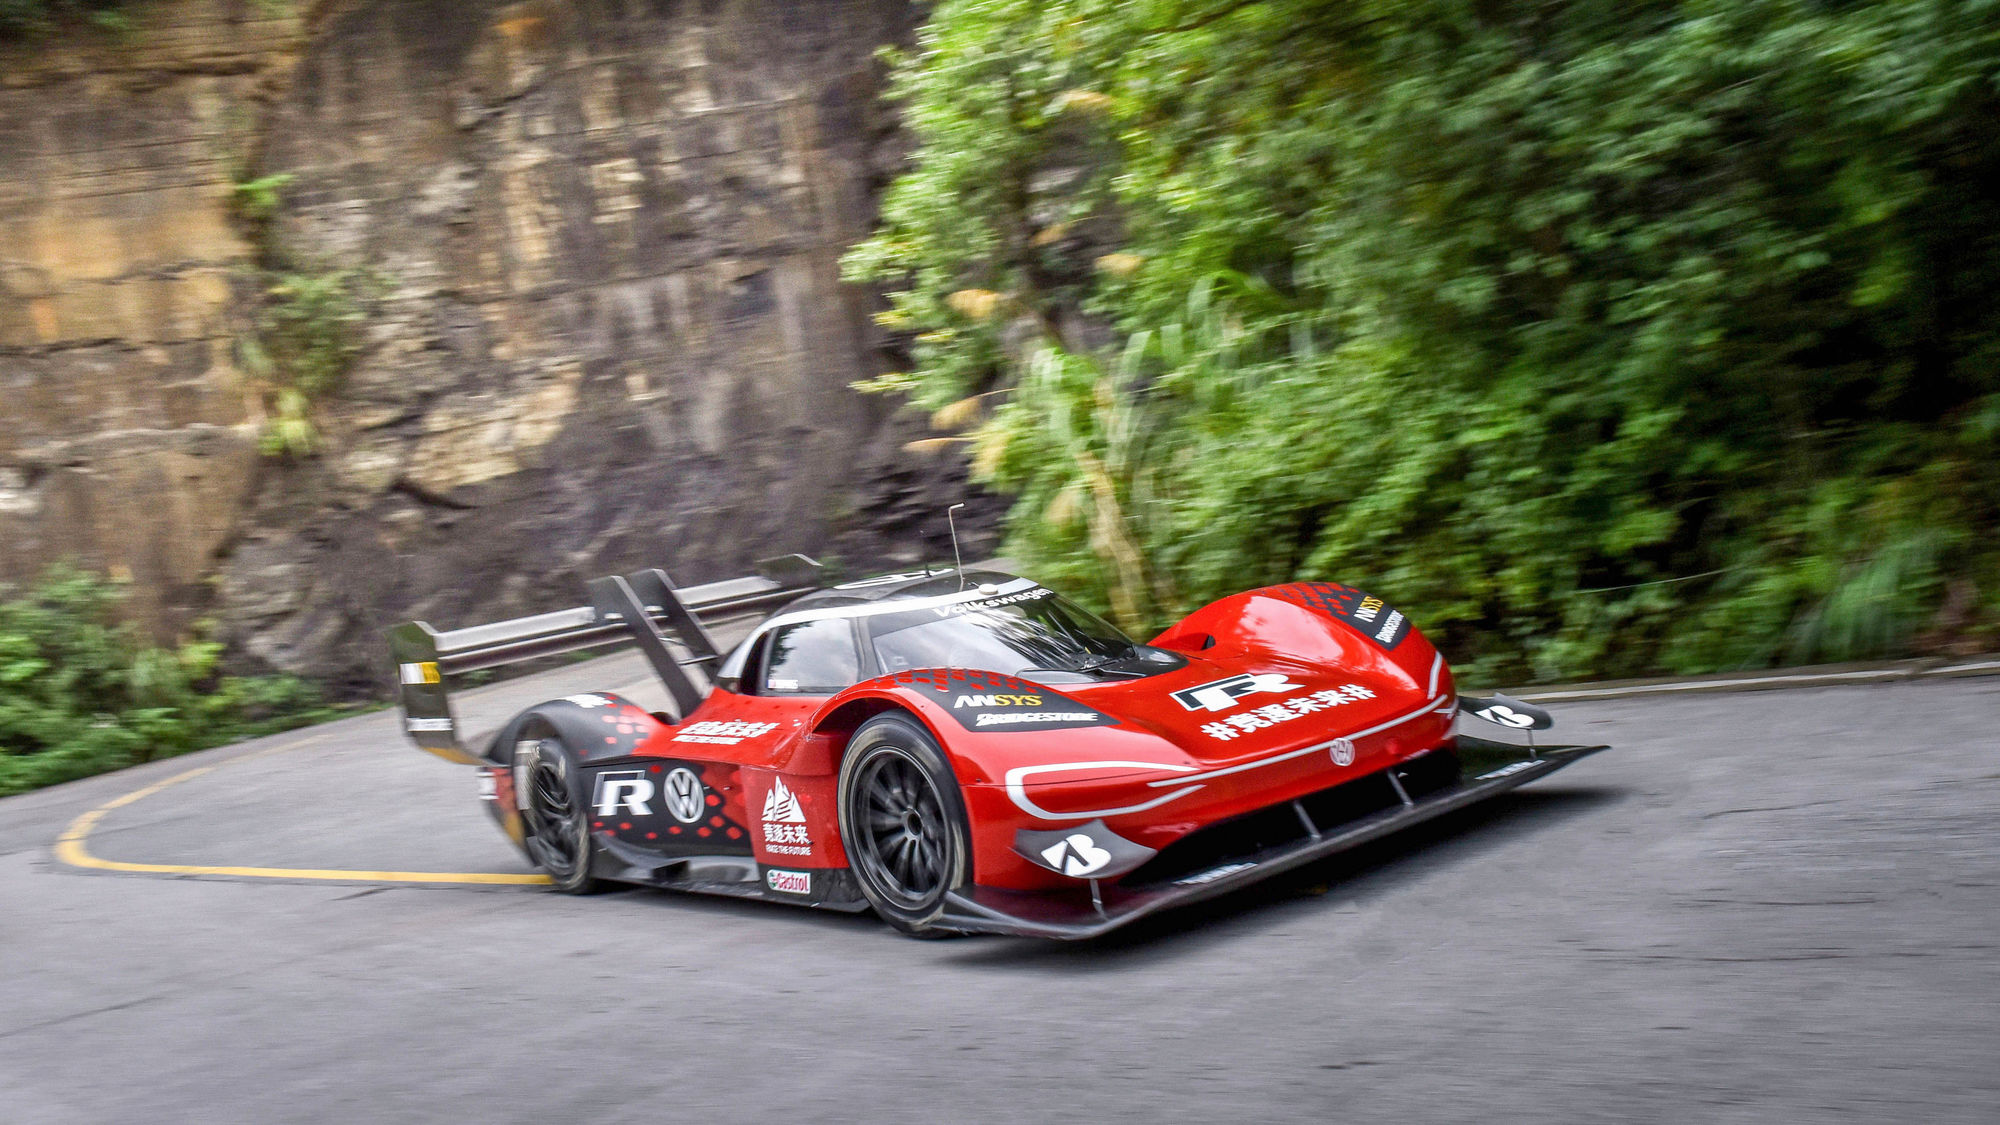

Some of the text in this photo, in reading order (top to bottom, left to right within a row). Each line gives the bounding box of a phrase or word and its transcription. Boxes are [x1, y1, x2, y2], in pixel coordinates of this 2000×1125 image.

[931, 587, 1054, 617] Volkswagen
[954, 694, 1043, 709] ANSYS
[593, 770, 655, 816] R
[773, 872, 809, 892] Castrol
